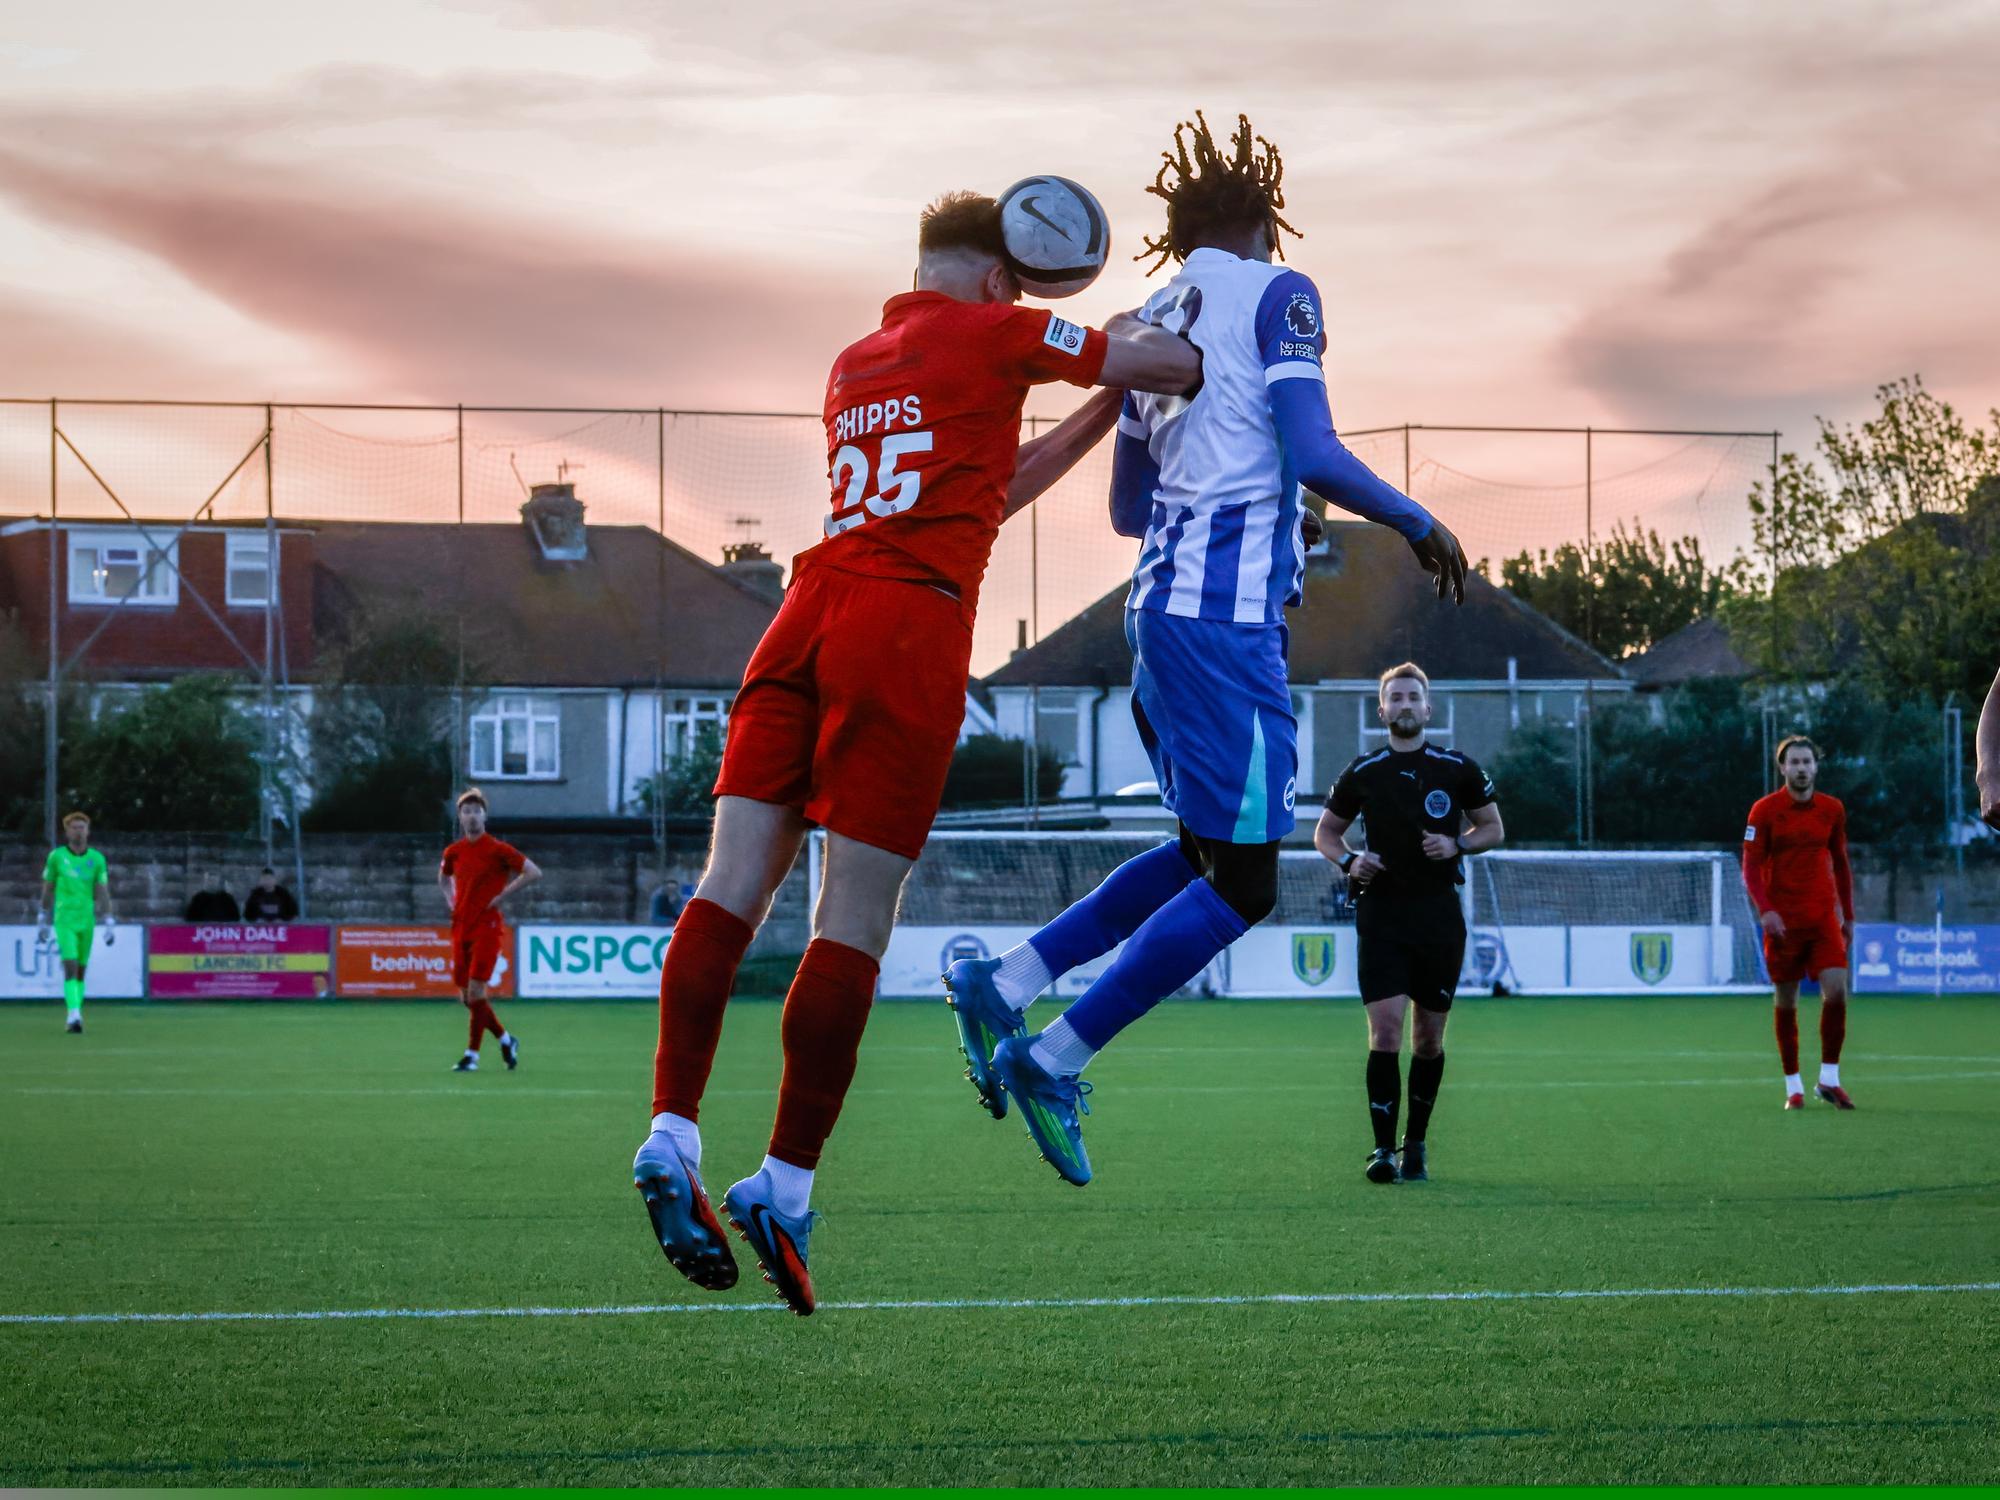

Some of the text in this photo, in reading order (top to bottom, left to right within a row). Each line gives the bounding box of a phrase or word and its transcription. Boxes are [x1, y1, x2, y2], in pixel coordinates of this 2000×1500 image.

[1280, 341, 1315, 354] No room
[1280, 348, 1294, 356] for
[834, 395, 922, 442] PHIPPS
[824, 431, 933, 539] 25
[192, 926, 287, 943] JOHN DALE
[193, 957, 287, 971] LANCING FC
[371, 952, 446, 972] beehive
[1897, 947, 1980, 967] facebook
